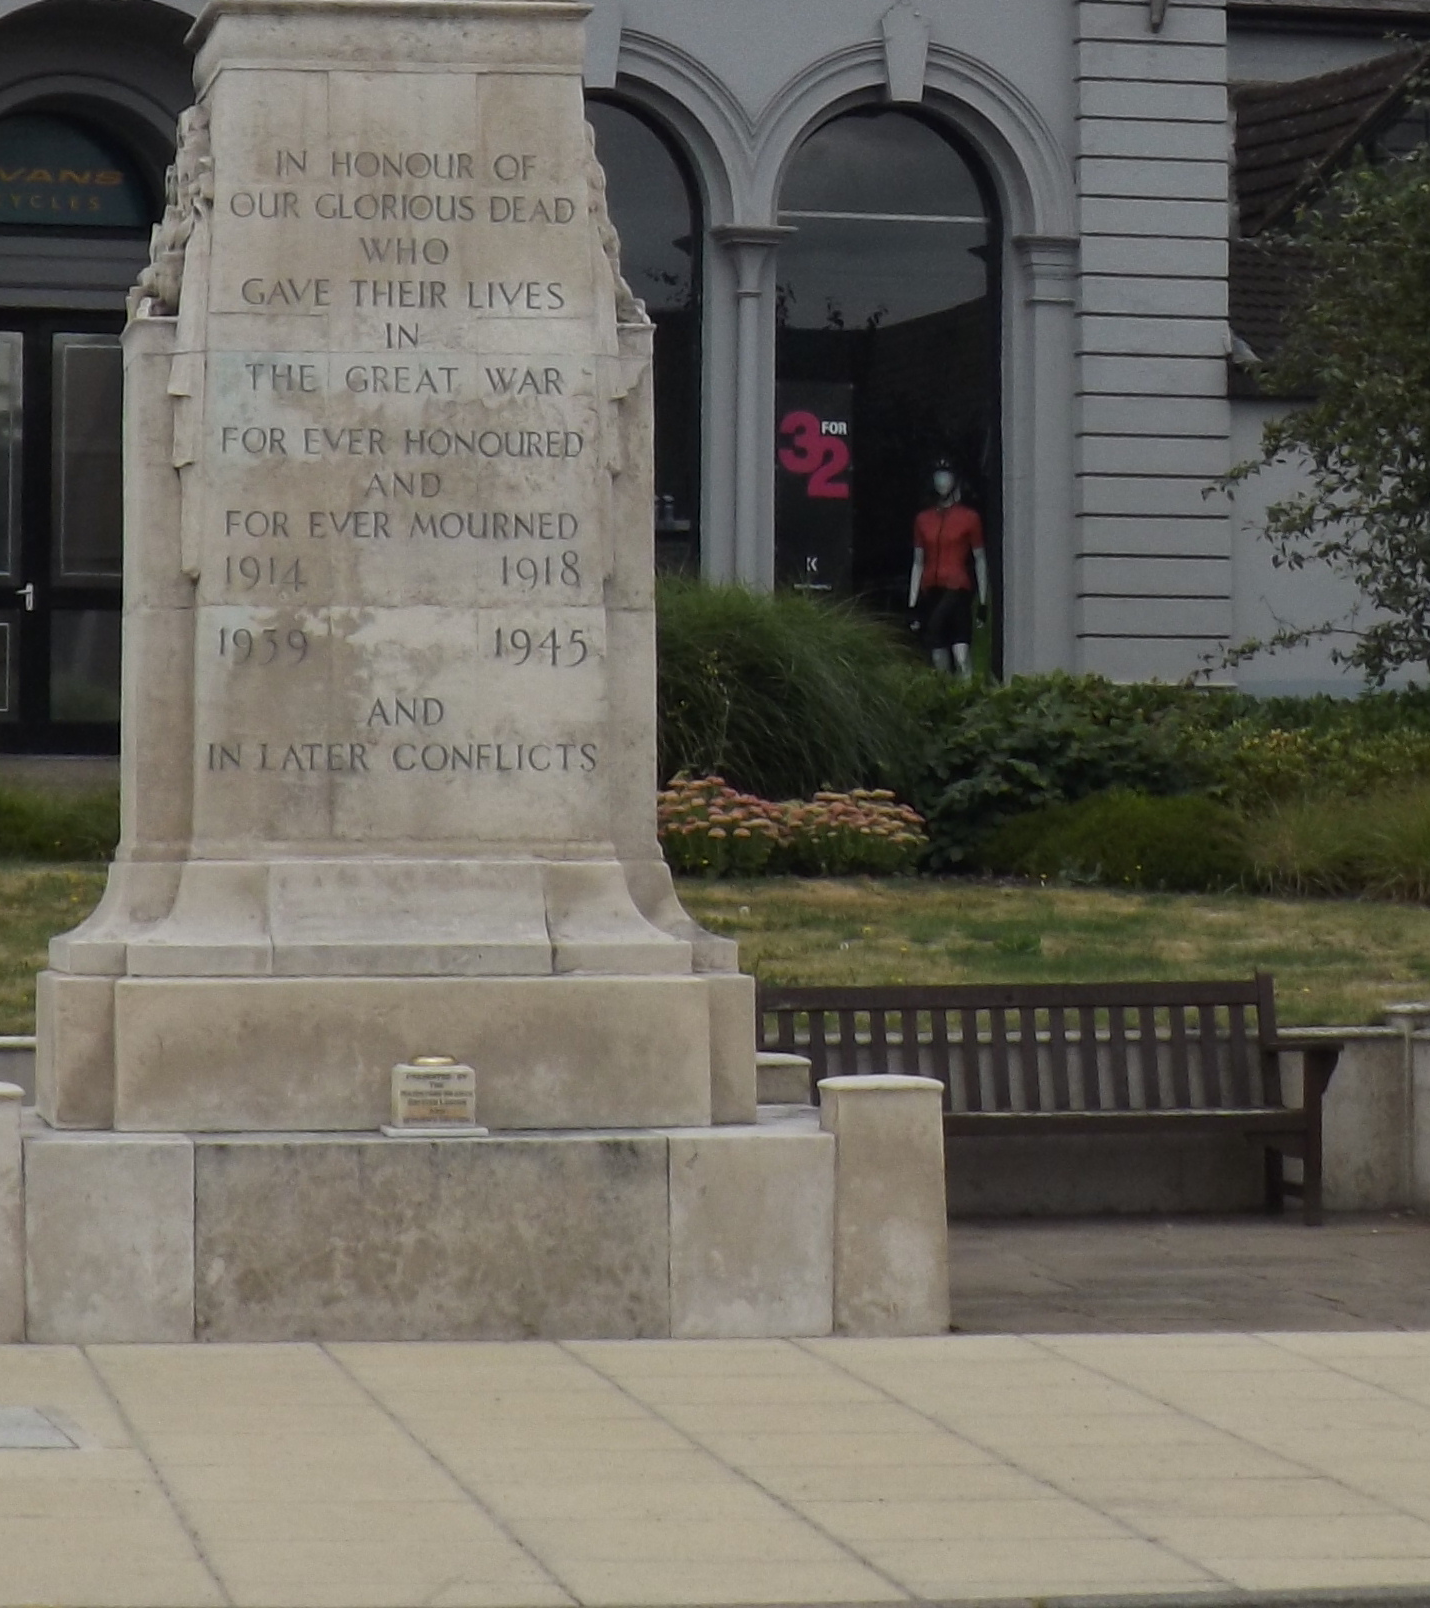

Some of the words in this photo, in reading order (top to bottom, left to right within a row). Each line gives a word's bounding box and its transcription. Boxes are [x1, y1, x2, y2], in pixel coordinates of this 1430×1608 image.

[276, 150, 307, 175] IN
[331, 151, 472, 181] HONOUR
[494, 153, 537, 181] OF
[230, 192, 300, 220] OUR
[315, 193, 474, 221] GLORIOUS
[489, 196, 575, 224] DEAD
[360, 237, 448, 265] WHO
[241, 278, 330, 307] GAVE
[351, 279, 446, 309] THEIR
[468, 281, 564, 310] LIVES
[386, 323, 419, 348] IN
[246, 363, 315, 392] THE
[346, 366, 458, 394] GREAT
[486, 366, 563, 395] WAR
[221, 427, 287, 455] FOR
[303, 428, 383, 456] EVER
[406, 429, 583, 459] HONOURED
[779, 411, 822, 473] 3
[821, 420, 848, 436] FOR
[808, 436, 850, 498] 2
[364, 472, 441, 499] AND
[225, 510, 288, 537] FOR
[309, 511, 390, 539] EVER
[410, 512, 578, 540] MOURNED
[224, 557, 306, 591] 1914
[502, 552, 580, 590] 1918
[218, 627, 309, 663] 1939
[495, 627, 588, 667] 1945
[368, 697, 444, 726] AND
[208, 742, 240, 771] IN
[258, 743, 369, 772] LATER
[393, 744, 597, 772] CONFLICTS
